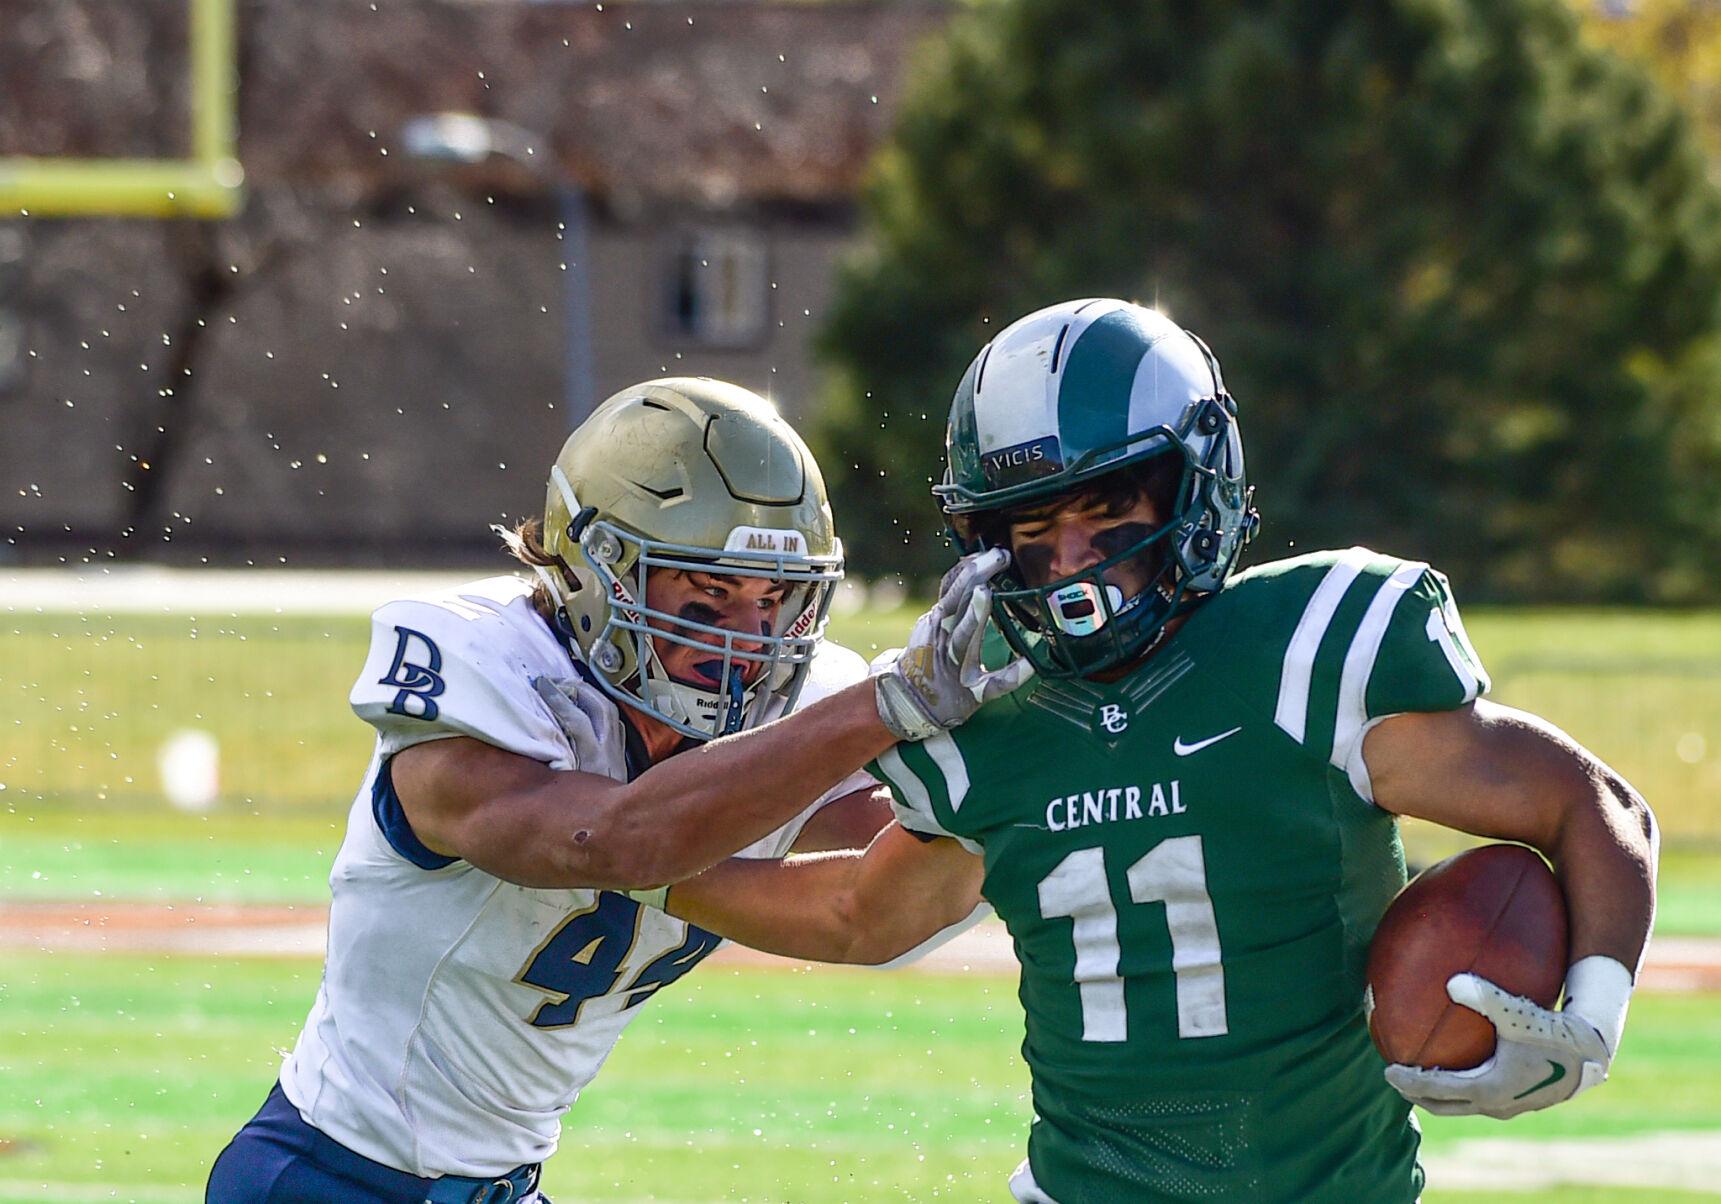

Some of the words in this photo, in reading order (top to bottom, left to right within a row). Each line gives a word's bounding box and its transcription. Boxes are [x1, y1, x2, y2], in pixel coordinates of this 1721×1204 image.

[992, 444, 1043, 470] VICIS
[746, 533, 776, 550] ALL
[783, 535, 799, 552] IN
[1046, 779, 1188, 833] CENTRAL
[1037, 834, 1229, 1042] 11
